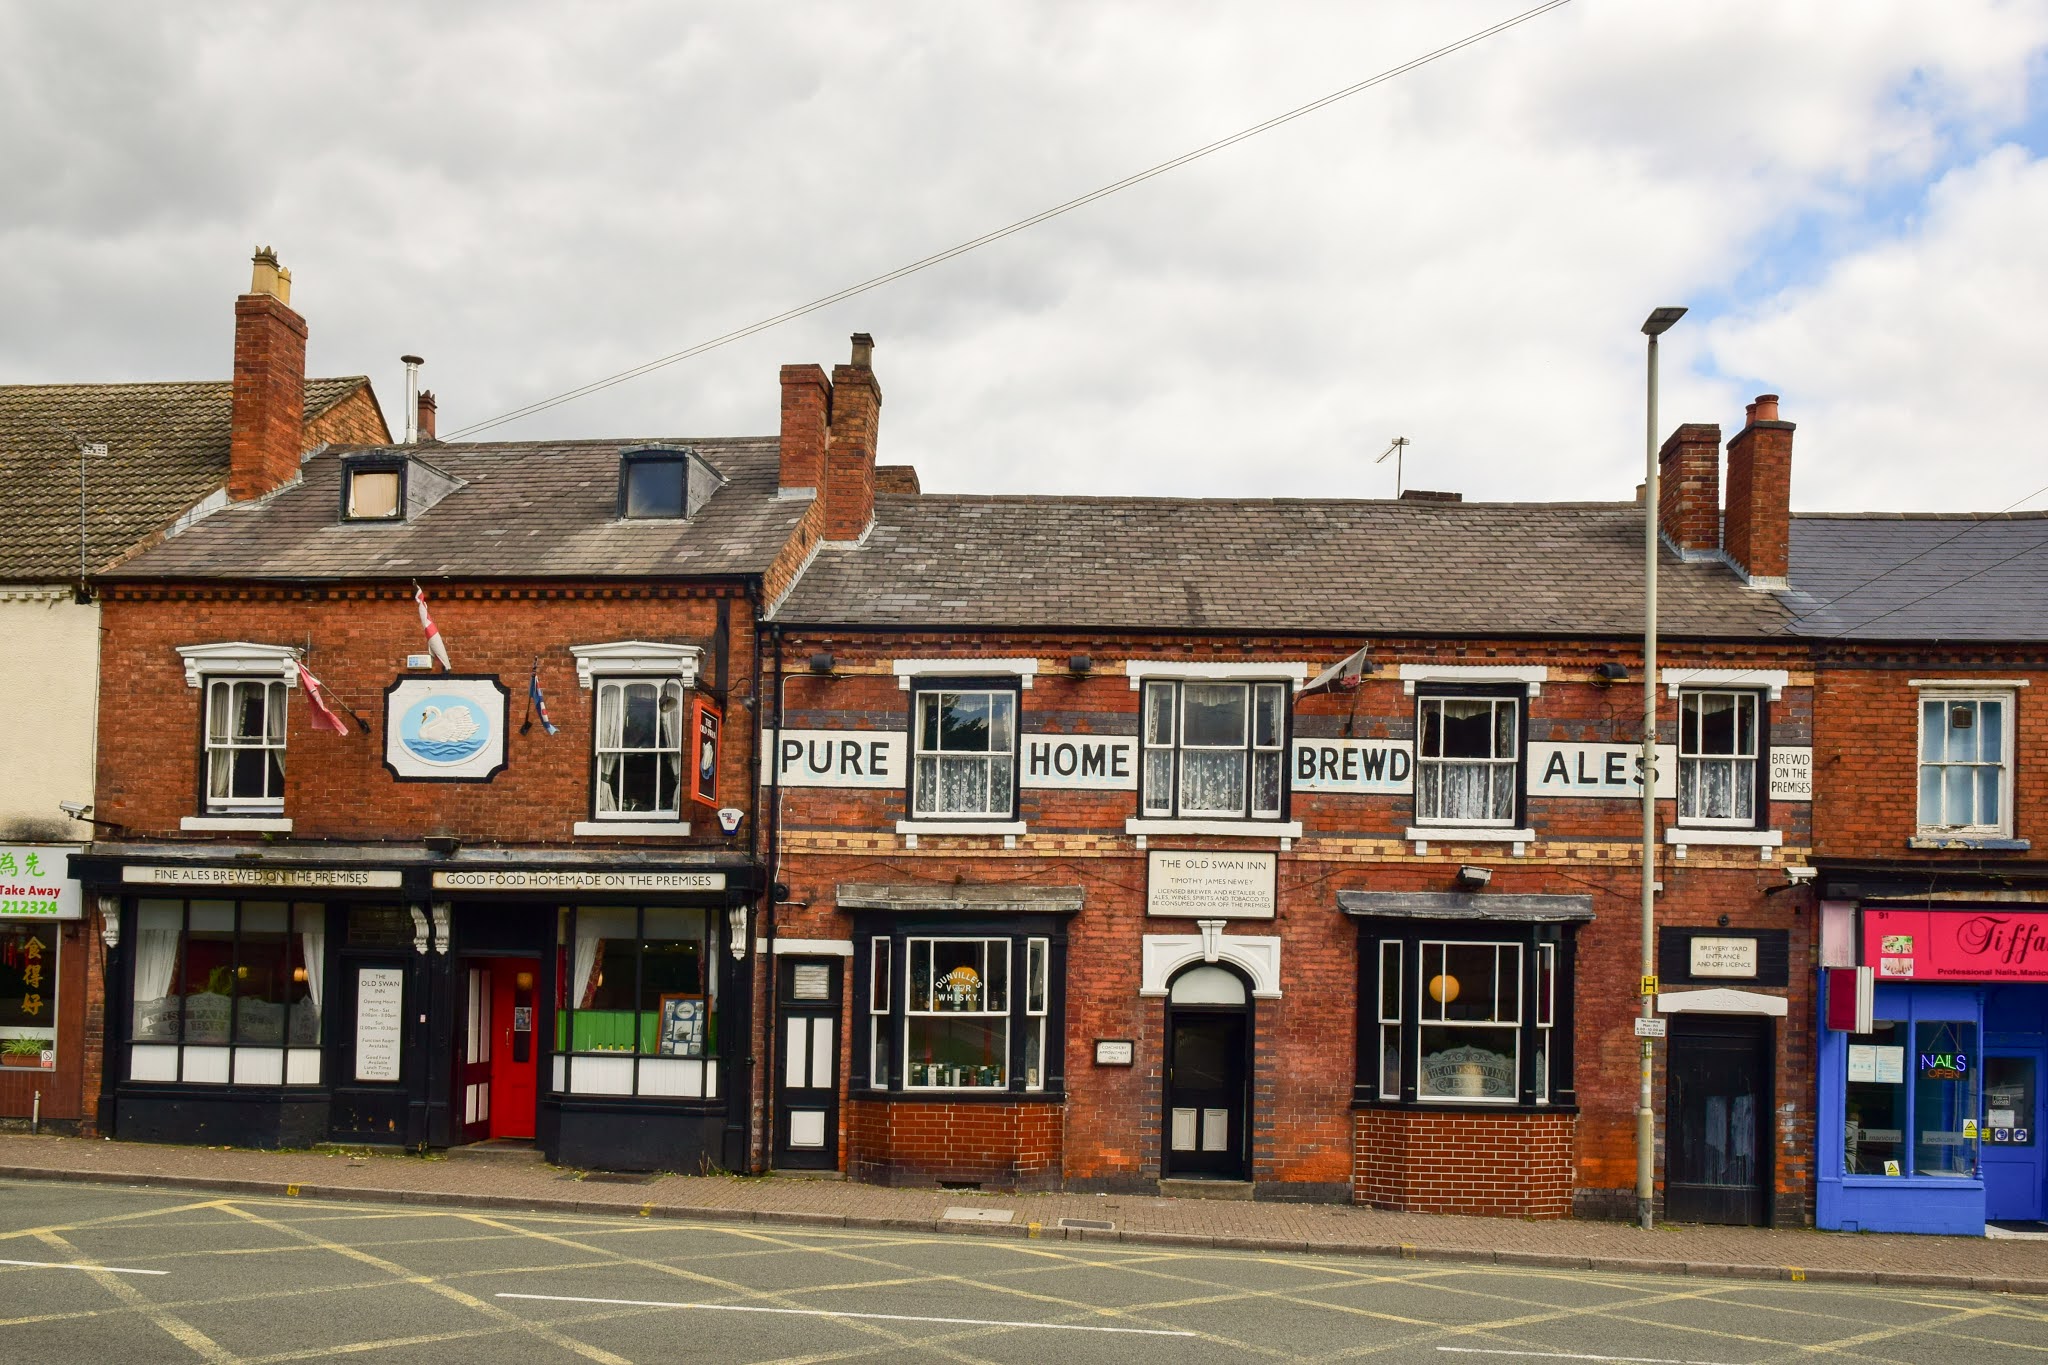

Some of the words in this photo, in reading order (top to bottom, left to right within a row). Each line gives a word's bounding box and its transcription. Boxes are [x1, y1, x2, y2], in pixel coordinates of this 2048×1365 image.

[781, 739, 890, 776] PURE
[1031, 743, 1131, 777] HOME
[1299, 746, 1412, 782] BREWD
[1543, 750, 1660, 786] ALES
[1772, 753, 1810, 765] BREWD
[1774, 768, 1788, 778] ON
[1791, 768, 1807, 778] THE
[1771, 781, 1811, 794] PREMISES
[1160, 859, 1181, 868] THE
[1185, 860, 1209, 869] OLD
[1212, 860, 1244, 870] SWAN
[1247, 862, 1267, 870] INN
[154, 869, 178, 880] FINE
[182, 870, 210, 880] ALES
[213, 870, 262, 881] BREWED
[266, 871, 286, 882] ON
[289, 872, 312, 882] THE
[316, 872, 368, 883] PREMISES
[446, 874, 486, 885] GOOD
[489, 875, 526, 885] FOOD
[530, 875, 601, 886] HOMEMADE
[605, 875, 624, 886] ON
[628, 875, 652, 886] THE
[656, 876, 711, 886] PREMISES
[0, 885, 25, 895] Take
[28, 886, 61, 899] Away
[1, 900, 58, 914] 212324
[1957, 916, 2048, 964] Tiffa
[935, 972, 983, 989] DUNVILLE'S
[1644, 978, 1655, 992] H
[1922, 1054, 1966, 1071] NAILS
[1444, 1065, 1461, 1075] OLD
[1928, 1069, 1960, 1079] OPEN
